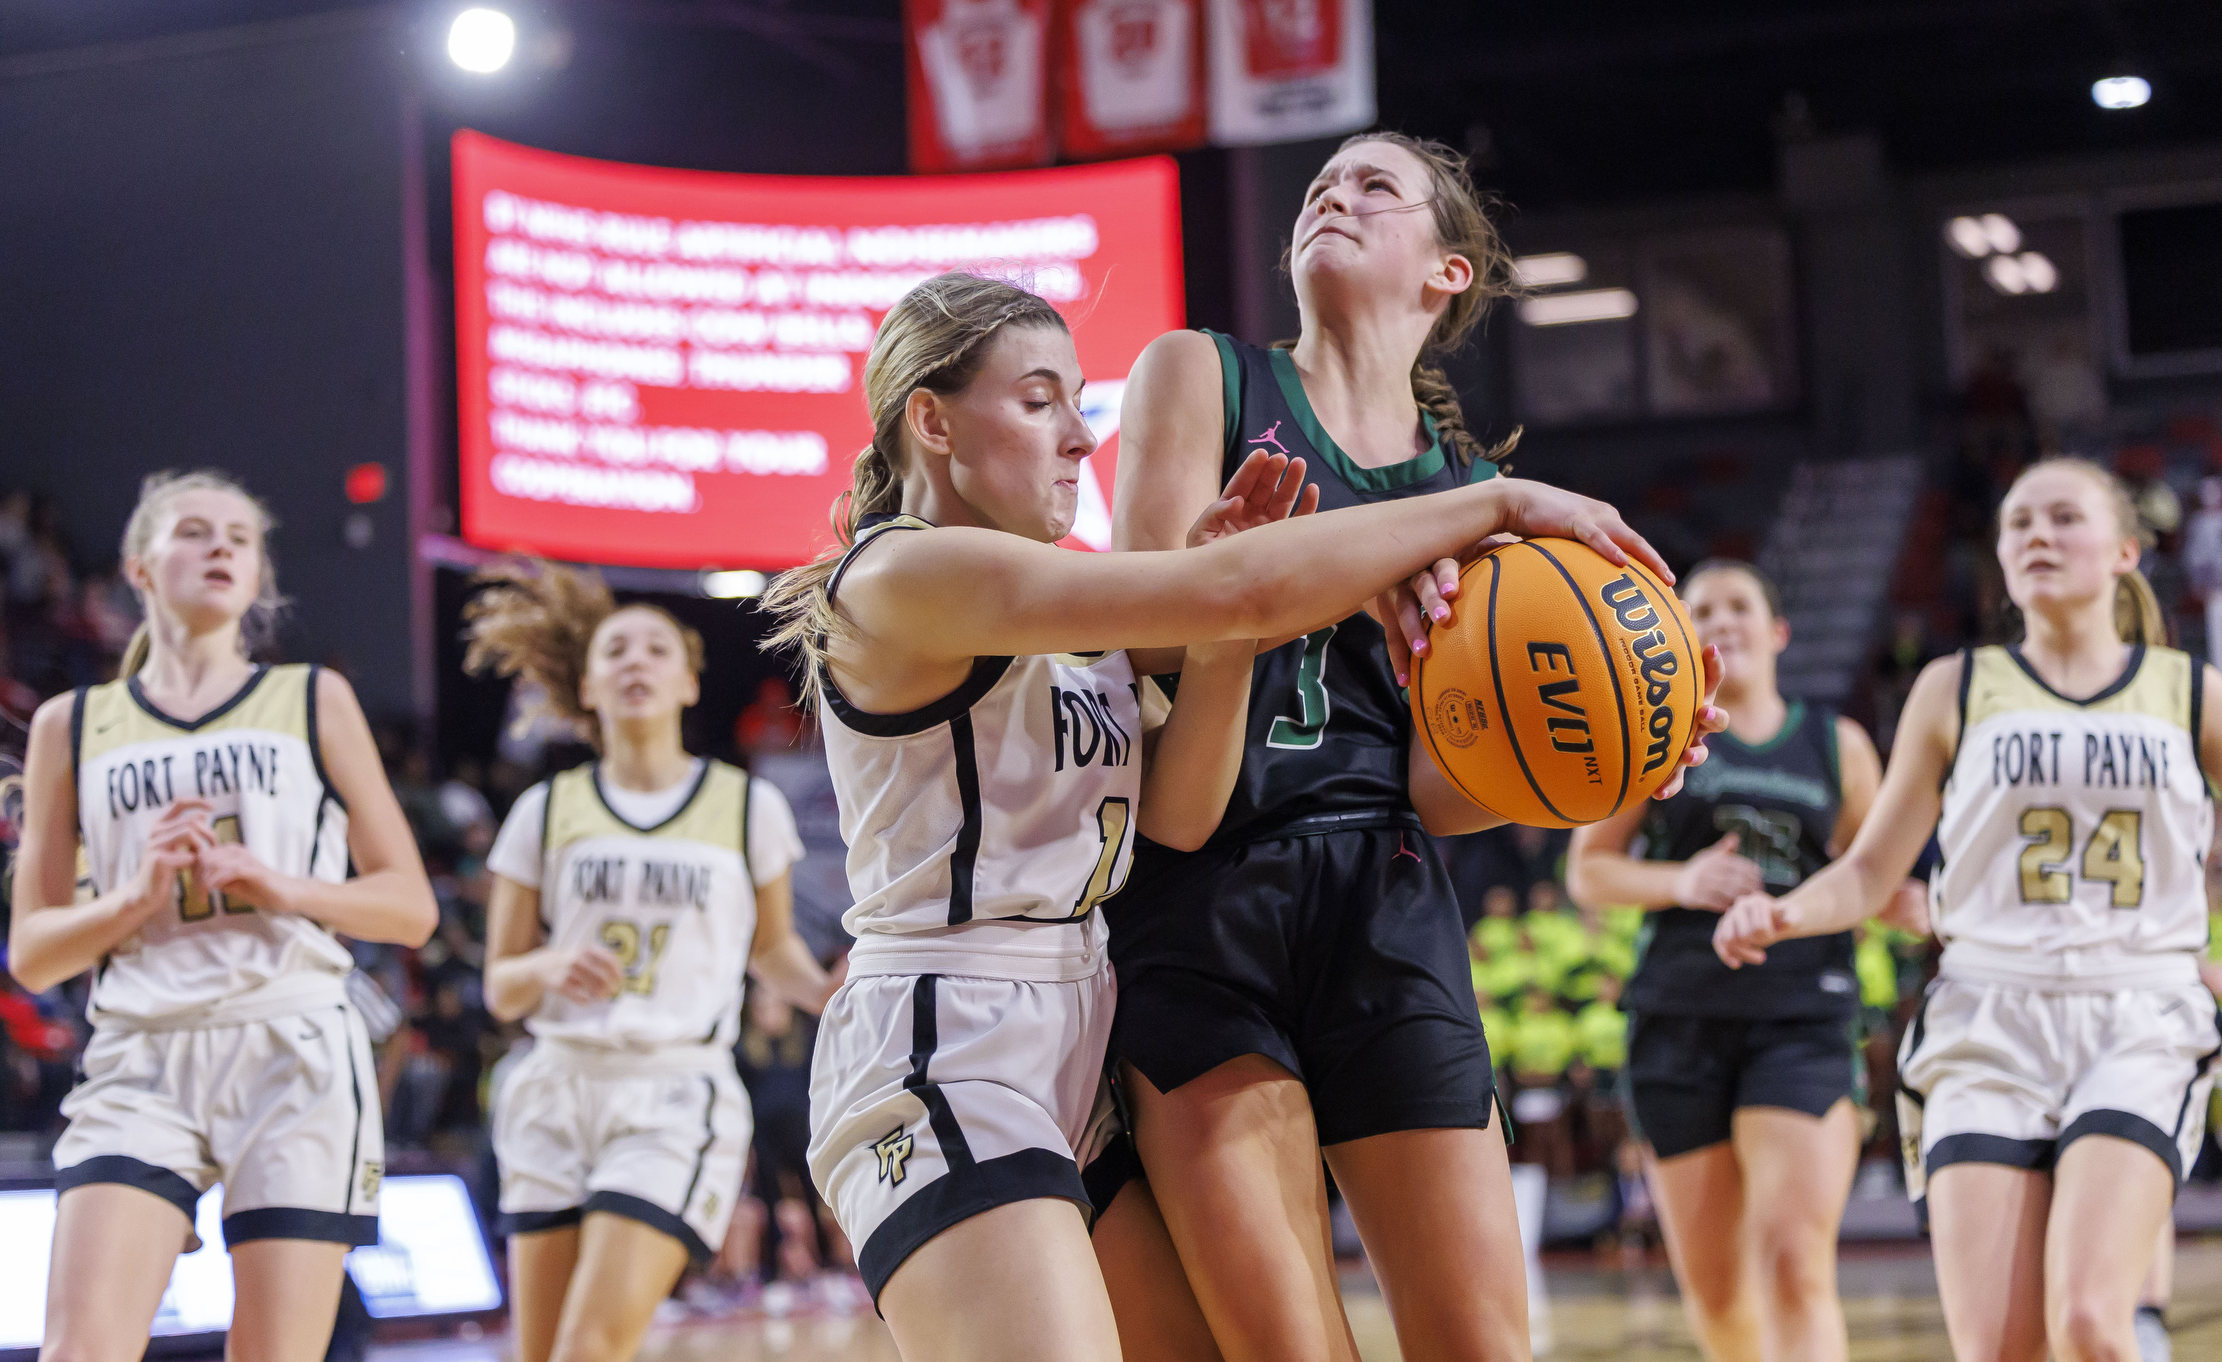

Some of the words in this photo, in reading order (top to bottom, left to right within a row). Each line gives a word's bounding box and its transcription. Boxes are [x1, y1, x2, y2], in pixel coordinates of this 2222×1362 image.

[1526, 640, 1595, 754] EVO
[1600, 573, 1678, 776] Wilson
[1619, 638, 1637, 676] INDOOR
[1633, 678, 1644, 706] GAME
[1050, 686, 1131, 772] FORT
[1993, 733, 2062, 788] FORT
[2085, 733, 2169, 789] PAYNE
[107, 755, 174, 820] FORT
[195, 743, 277, 799] PAYNE
[1584, 756, 1603, 786] NXT
[2018, 807, 2145, 908] 24
